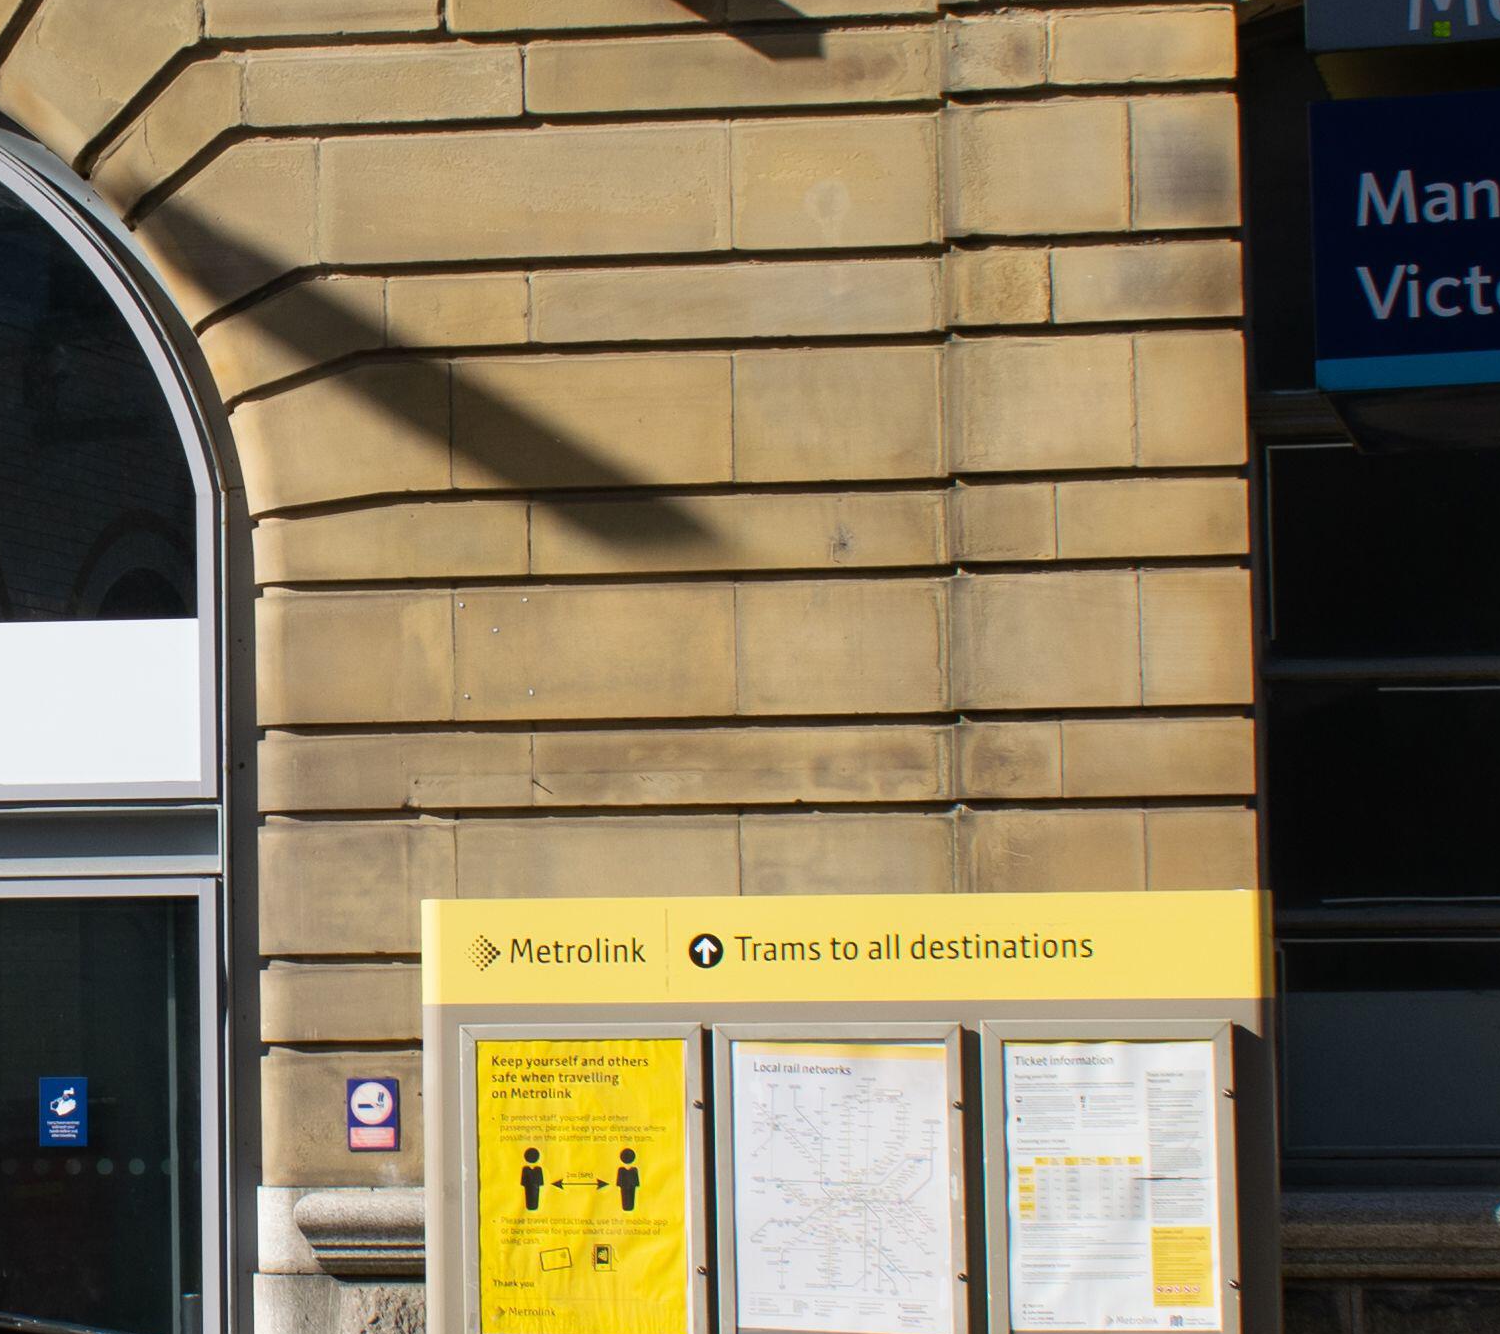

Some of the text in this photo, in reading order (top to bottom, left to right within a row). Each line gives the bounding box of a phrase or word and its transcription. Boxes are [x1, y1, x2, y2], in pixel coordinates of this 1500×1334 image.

[510, 933, 1094, 964] Metrolink Trams to all destinations
[491, 1056, 649, 1068] Keep yourself and others
[1014, 1056, 1115, 1067] Ticket information
[753, 1062, 852, 1076] Local rail networks
[491, 1072, 620, 1086] safe when travelling
[491, 1088, 572, 1099] on Metrolink
[493, 1279, 534, 1288] Thank you
[508, 1306, 556, 1317] Metrolink
